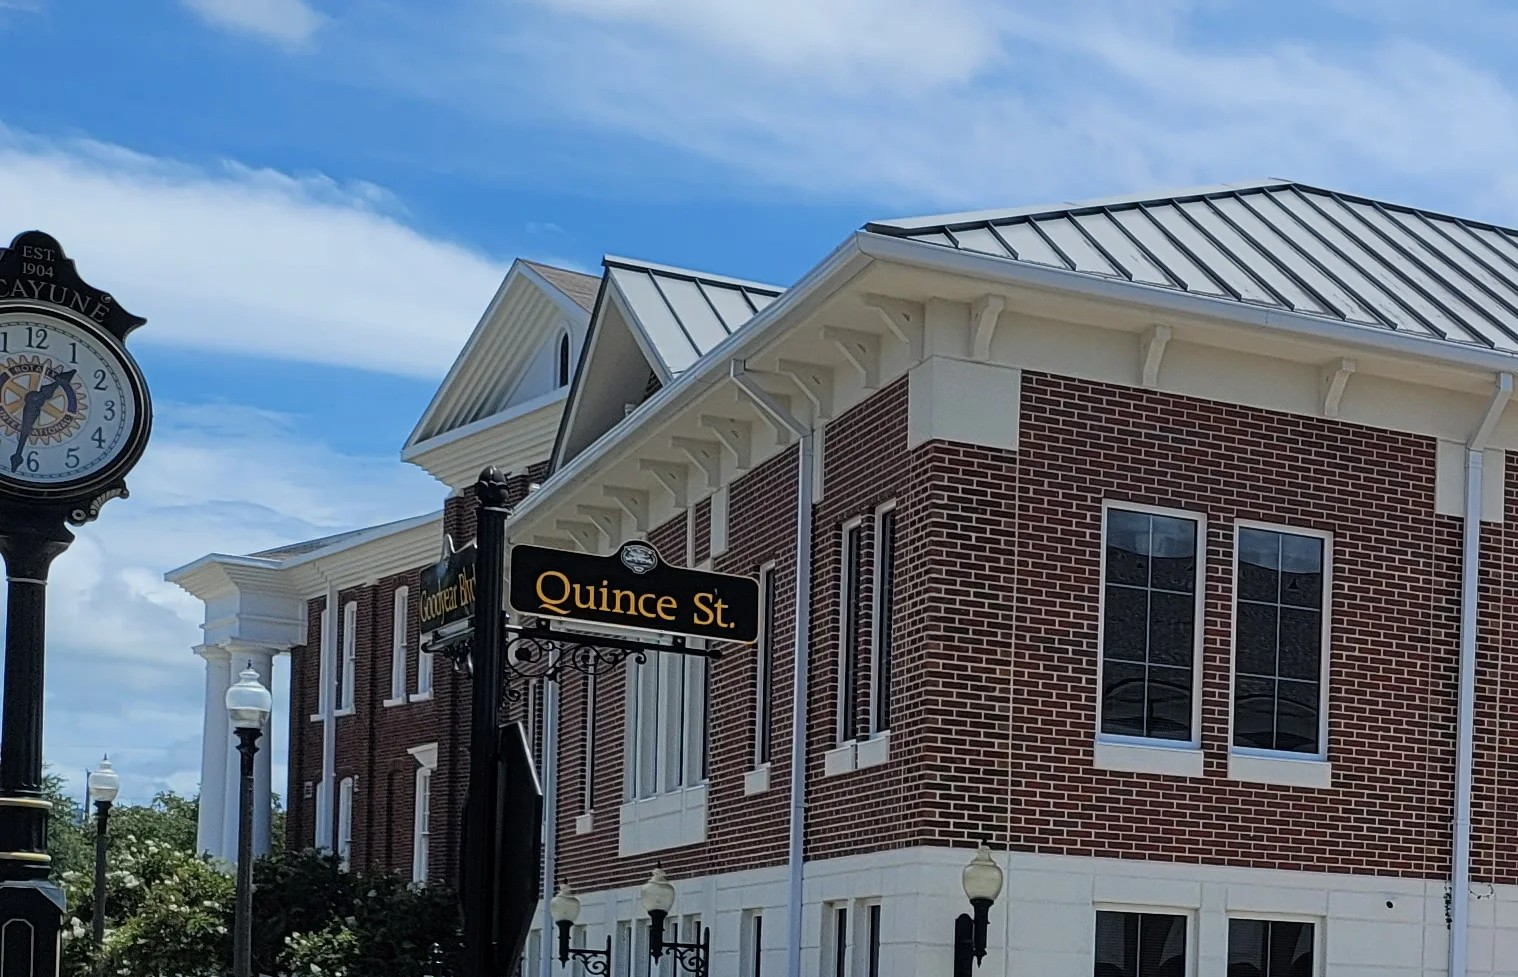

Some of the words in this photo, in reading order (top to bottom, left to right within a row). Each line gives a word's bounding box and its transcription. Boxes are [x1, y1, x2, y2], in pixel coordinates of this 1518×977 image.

[22, 262, 55, 278] 1904
[26, 327, 49, 350] 12
[69, 343, 78, 364] 1
[93, 369, 108, 391] 2
[104, 400, 116, 421] 3
[91, 426, 106, 449] 4
[26, 451, 39, 472] 6
[65, 448, 80, 468] 5
[420, 577, 458, 625] Goodyear
[535, 570, 678, 620] Quince
[693, 592, 735, 629] St.
